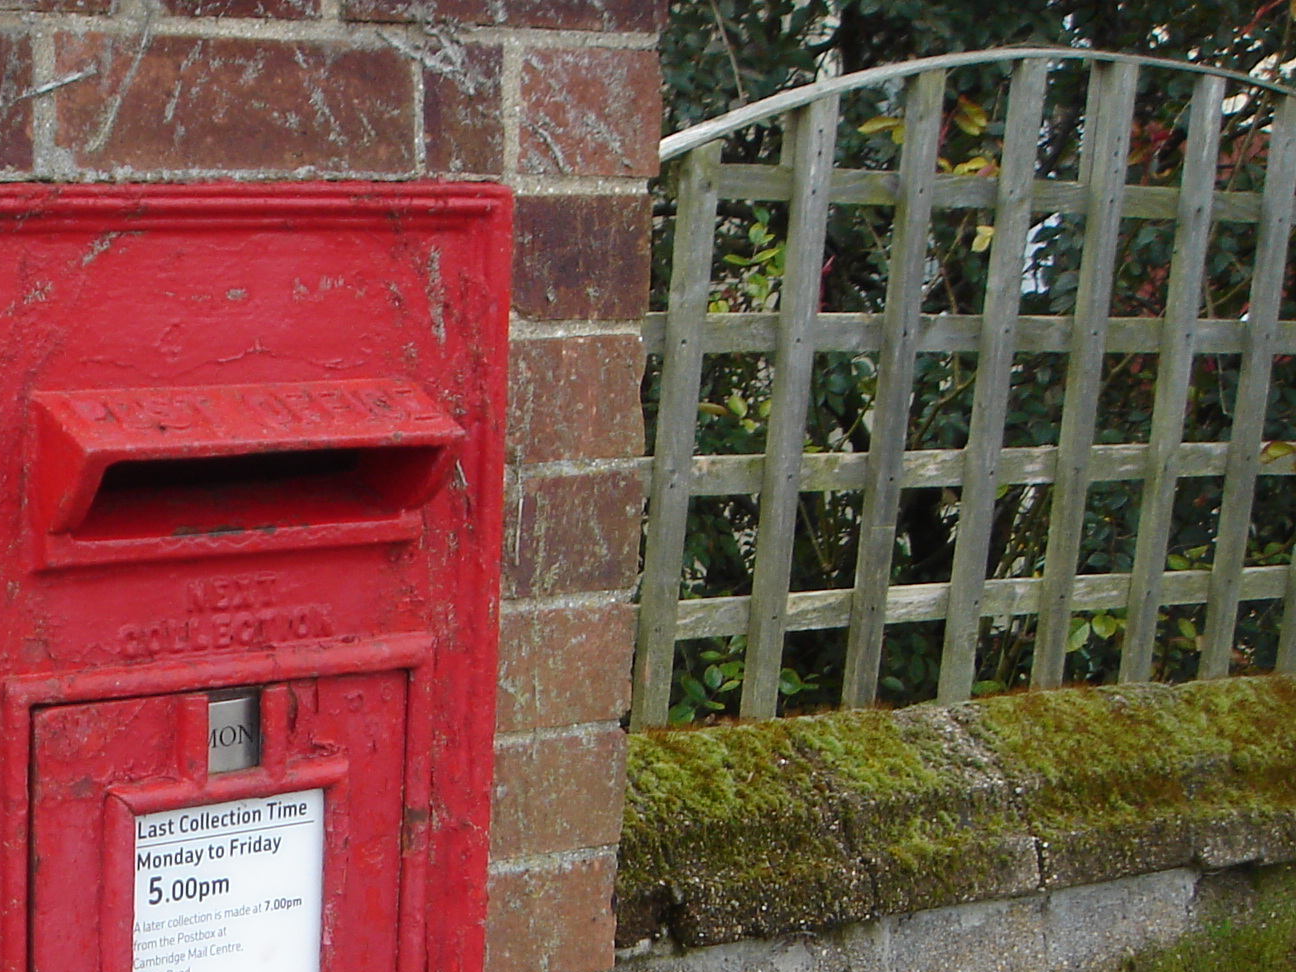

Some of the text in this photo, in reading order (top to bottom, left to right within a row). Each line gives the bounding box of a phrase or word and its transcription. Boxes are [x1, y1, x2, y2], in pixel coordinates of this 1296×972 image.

[186, 570, 278, 613] NEXT
[116, 603, 335, 658] COLLECTION
[137, 801, 308, 840] Last Collection Time
[137, 834, 282, 871] Monday to Friday
[148, 875, 230, 905] 5.00pm
[134, 897, 303, 934] A later collection is made at 7.00pm
[133, 926, 227, 952] from the Postbox at
[133, 951, 186, 970] Cambridge
[187, 946, 208, 960] Mail
